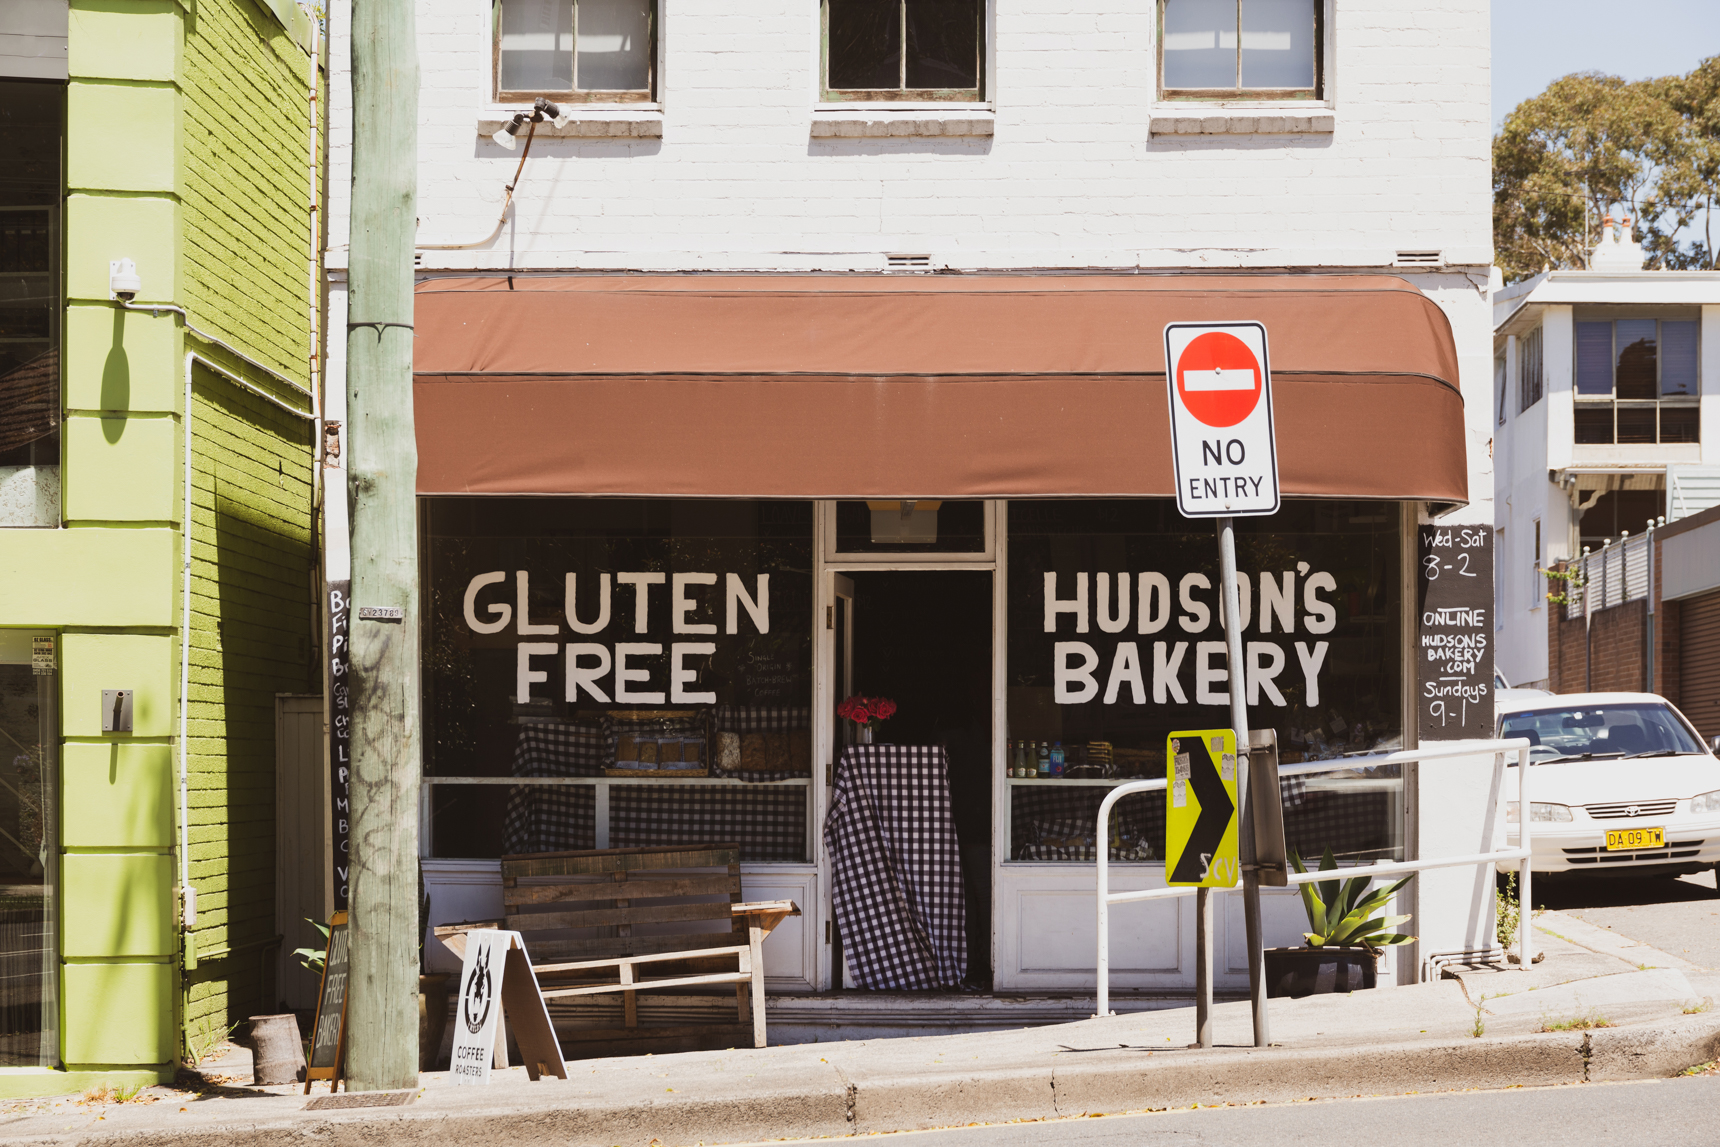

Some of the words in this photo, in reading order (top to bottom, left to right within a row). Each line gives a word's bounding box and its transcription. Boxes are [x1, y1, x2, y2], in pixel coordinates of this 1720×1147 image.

[1202, 438, 1246, 467] NO
[1189, 476, 1263, 500] ENTRY
[463, 570, 770, 635] GLUTEN
[1043, 561, 1337, 634] HUDSON'S
[1423, 608, 1485, 627] ONLINE
[1421, 633, 1487, 648] HUDSONS
[1427, 648, 1485, 662] BAKERY
[516, 642, 717, 704] FREE
[1054, 641, 1329, 707] BAKERY
[1423, 681, 1488, 704] Sundays
[1609, 833, 1624, 846] DA
[1628, 831, 1642, 844] 09
[1646, 830, 1661, 843] TW
[324, 972, 347, 1005] FREE
[457, 1045, 484, 1061] COFFEE
[455, 1064, 482, 1077] ROASTERS
